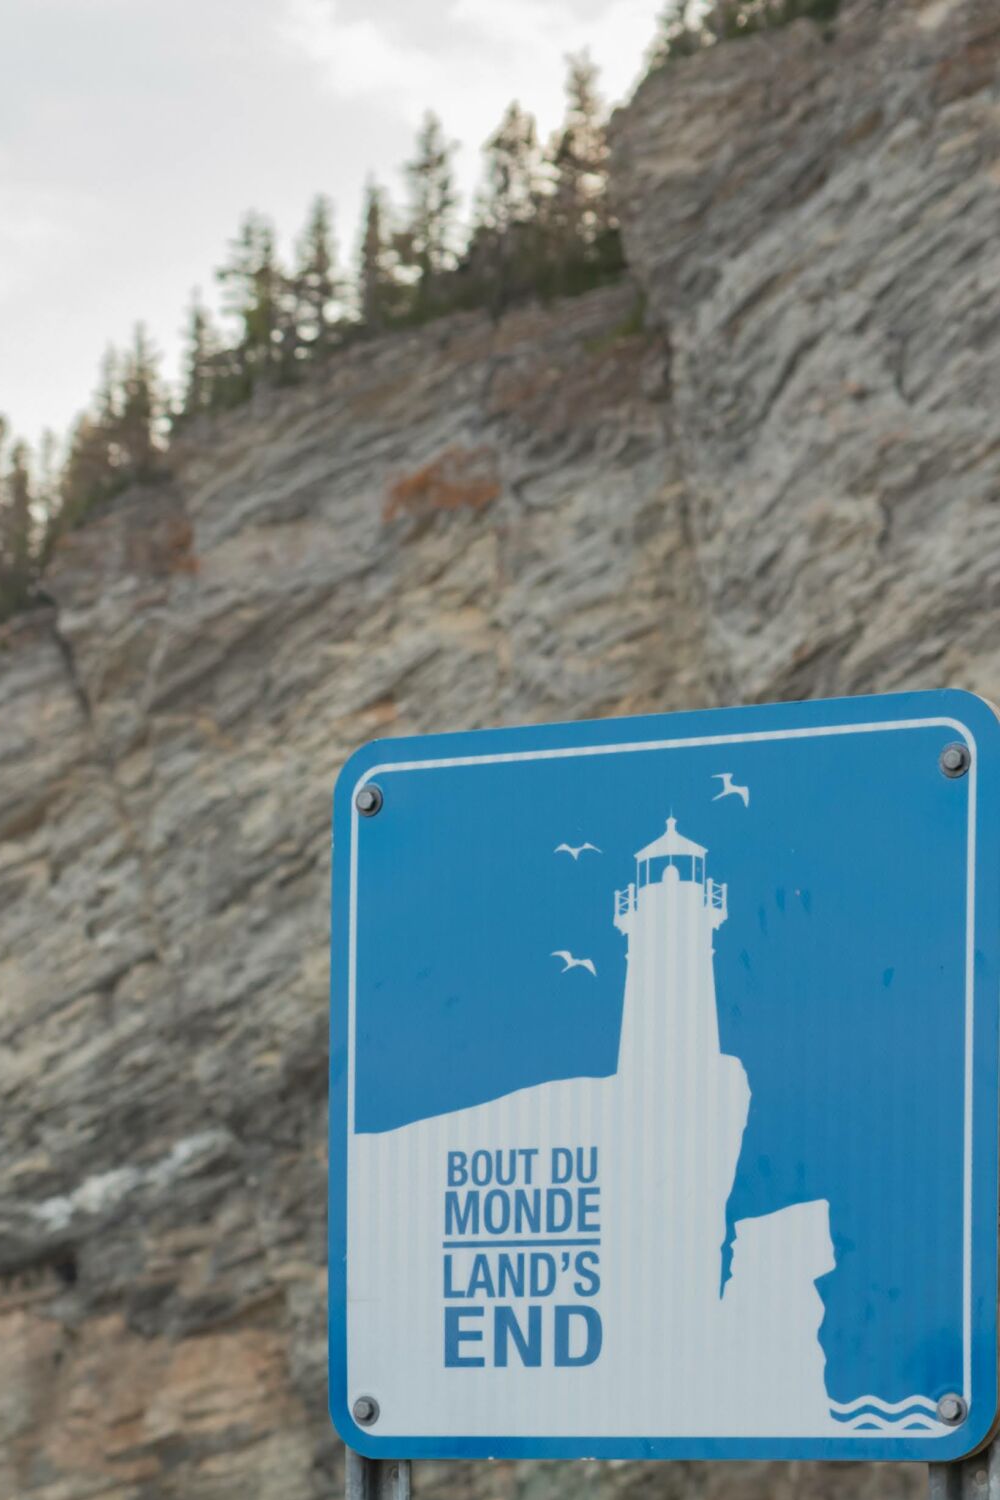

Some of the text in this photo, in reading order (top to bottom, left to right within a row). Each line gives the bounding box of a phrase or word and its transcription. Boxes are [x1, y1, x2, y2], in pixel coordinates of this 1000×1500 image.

[447, 1145, 598, 1188] BOUT DU
[444, 1186, 601, 1236] MONDE
[443, 1250, 601, 1299] LAND'S
[443, 1304, 603, 1369] END
